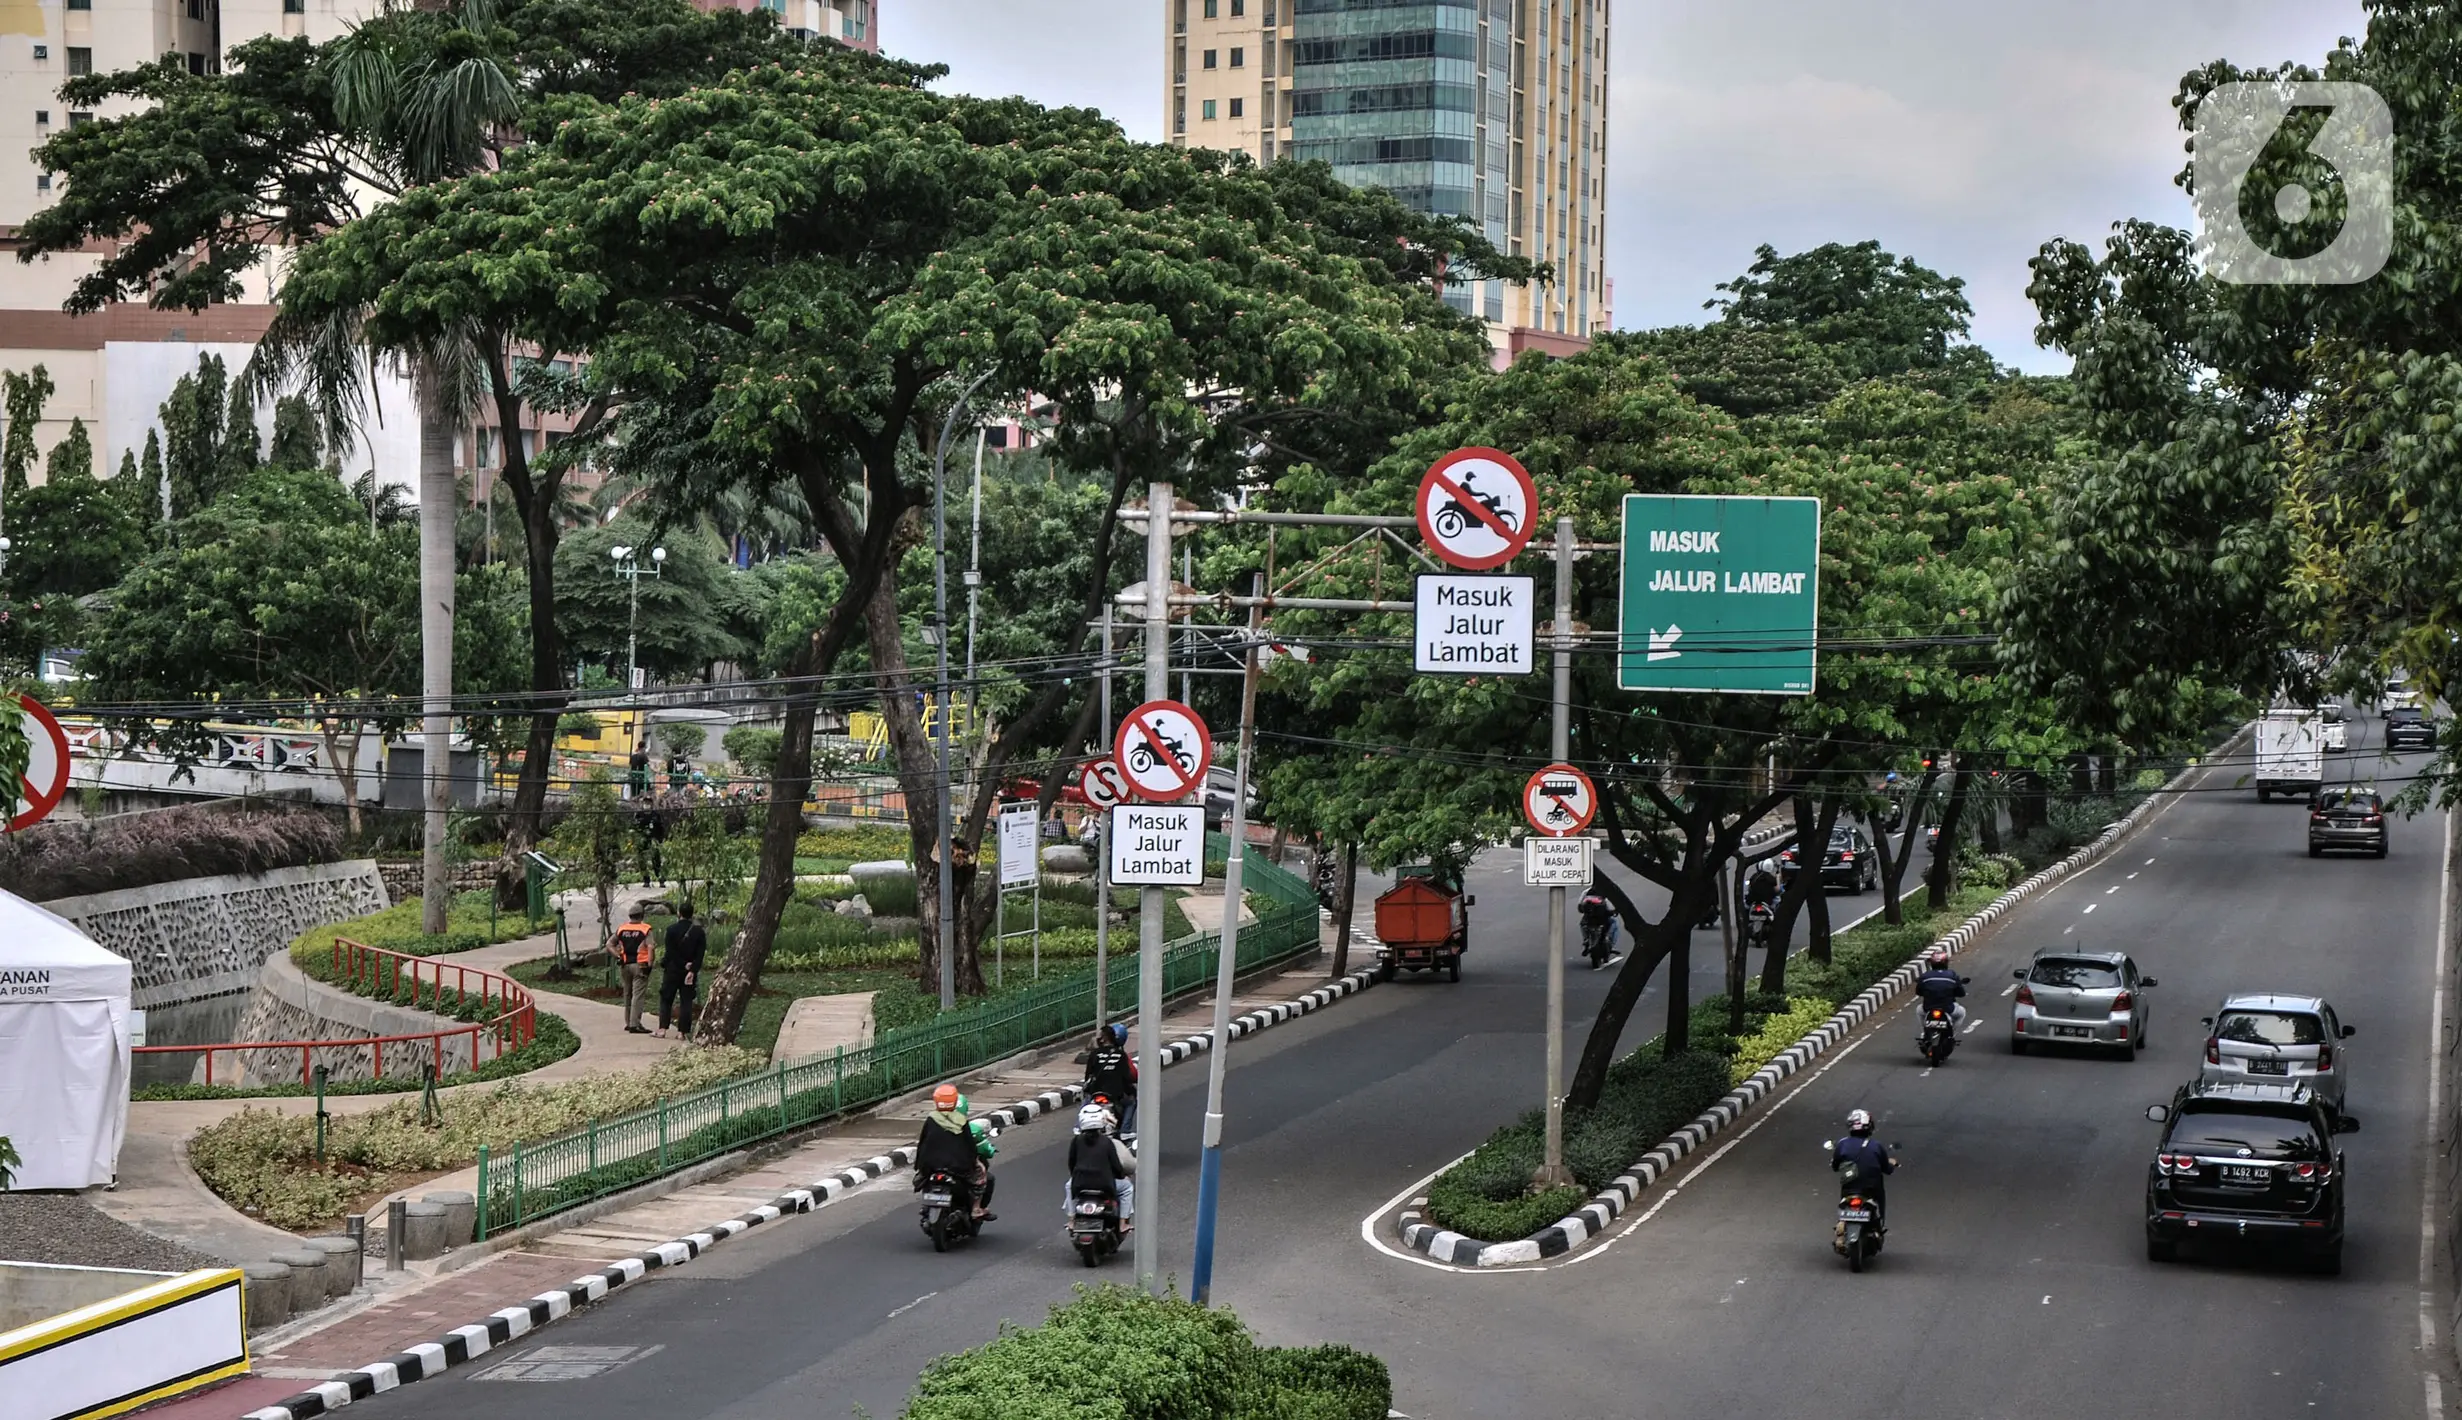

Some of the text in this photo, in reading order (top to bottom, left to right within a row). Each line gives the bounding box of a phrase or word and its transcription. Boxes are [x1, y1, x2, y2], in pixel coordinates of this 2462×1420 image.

[1650, 531, 1720, 553] MASUK
[1649, 569, 1805, 594] JALUR LAMBAT
[1437, 585, 1513, 607] Masuk
[1444, 614, 1505, 635] Jalur
[1429, 641, 1519, 663] Lambat
[1129, 813, 1188, 830] Masuk
[1134, 835, 1182, 852] Jalur
[1537, 844, 1580, 854] DILARANG
[1122, 857, 1192, 874] Lambat
[1544, 857, 1573, 867] MASUK
[1531, 870, 1587, 879] JALUR CEPAT
[0, 970, 50, 984] ANAN
[11, 985, 50, 996] PUSAT
[2222, 1165, 2229, 1176] B
[2232, 1167, 2251, 1177] 1492
